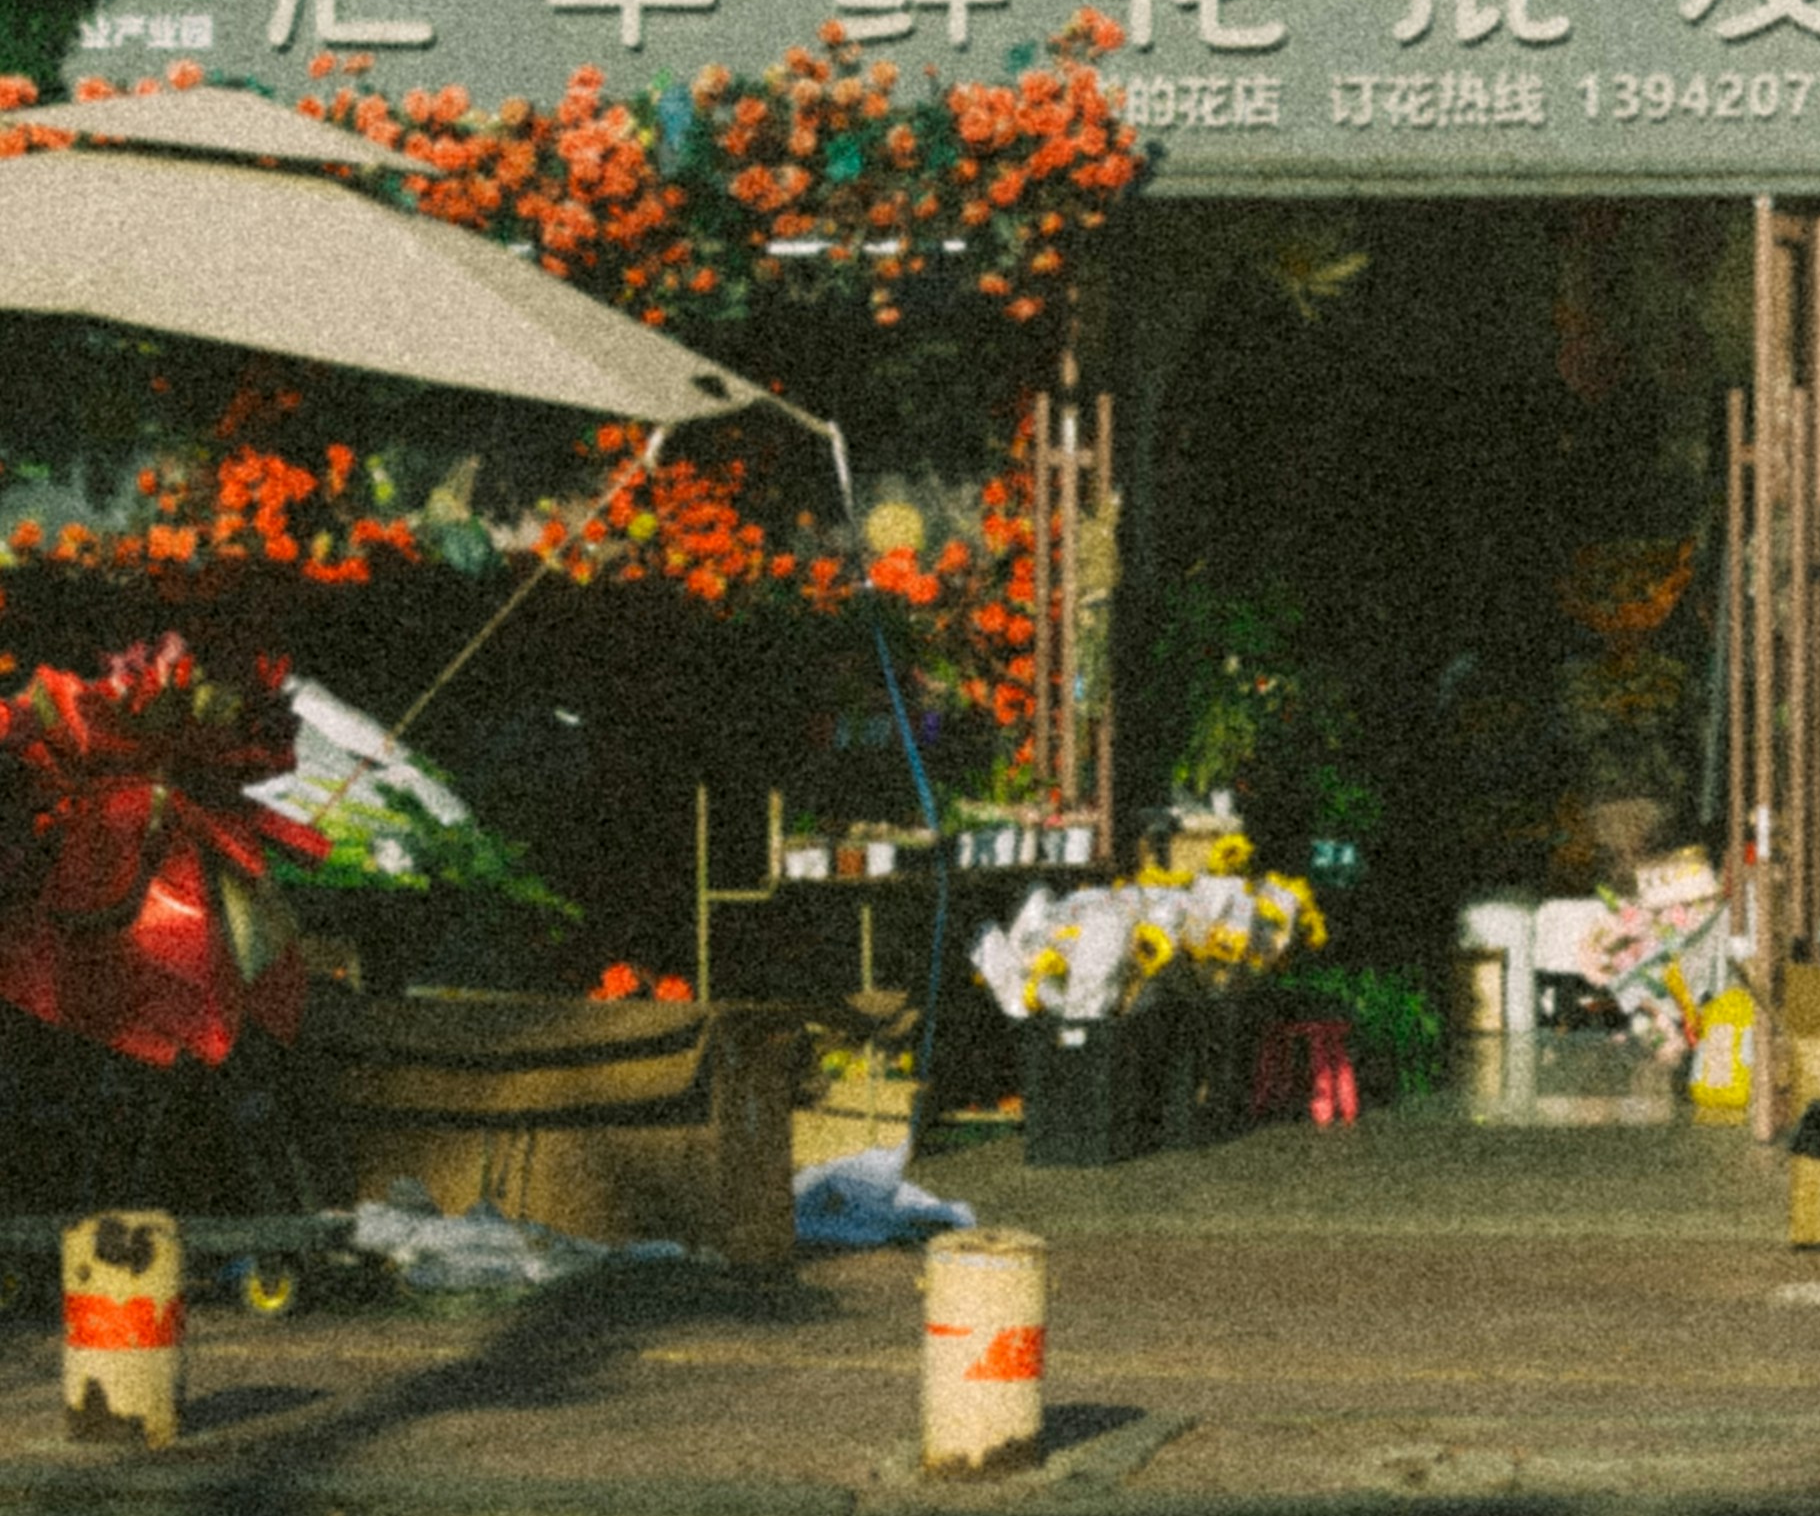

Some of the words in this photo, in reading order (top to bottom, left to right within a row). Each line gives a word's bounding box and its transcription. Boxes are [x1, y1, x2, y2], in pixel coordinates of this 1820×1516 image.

[1102, 75, 1280, 126] 的花店
[1330, 73, 1546, 127] 订花热线
